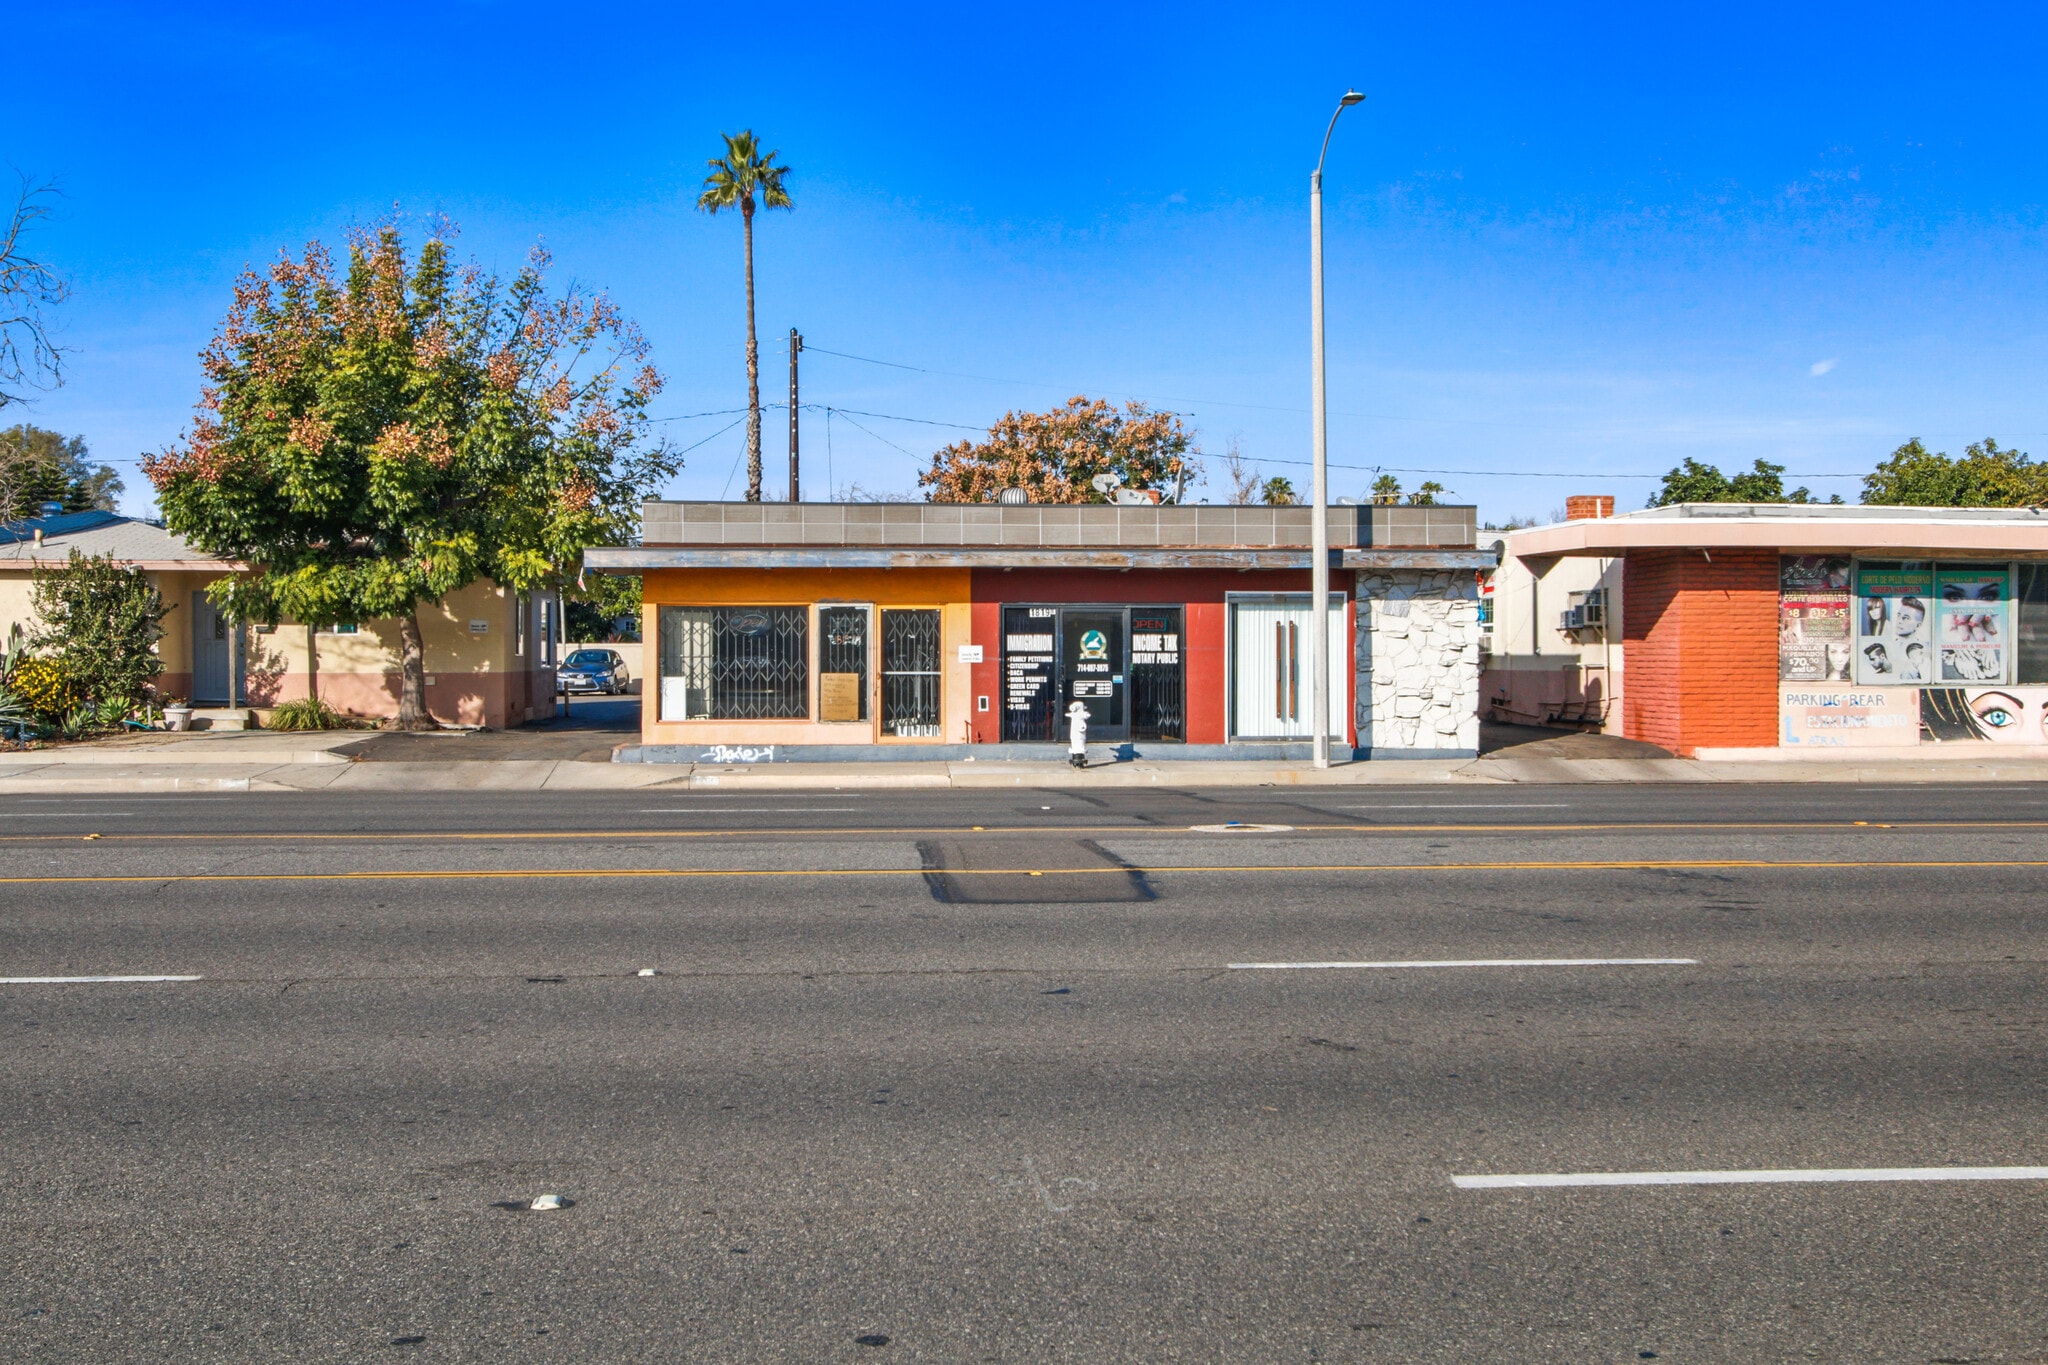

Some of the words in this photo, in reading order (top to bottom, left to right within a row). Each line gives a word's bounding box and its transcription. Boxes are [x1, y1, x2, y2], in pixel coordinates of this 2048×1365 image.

[1030, 608, 1051, 617] 1819
[1788, 608, 1800, 618] $8
[1007, 634, 1052, 651] IMMIGRATION
[1132, 634, 1162, 651] INCOME
[1132, 652, 1155, 664] NOTARY
[1156, 652, 1178, 664] PUBLIC
[1786, 693, 1840, 706] PARKING
[1849, 694, 1885, 706] REAR
[1808, 735, 1845, 746] ATRAS
